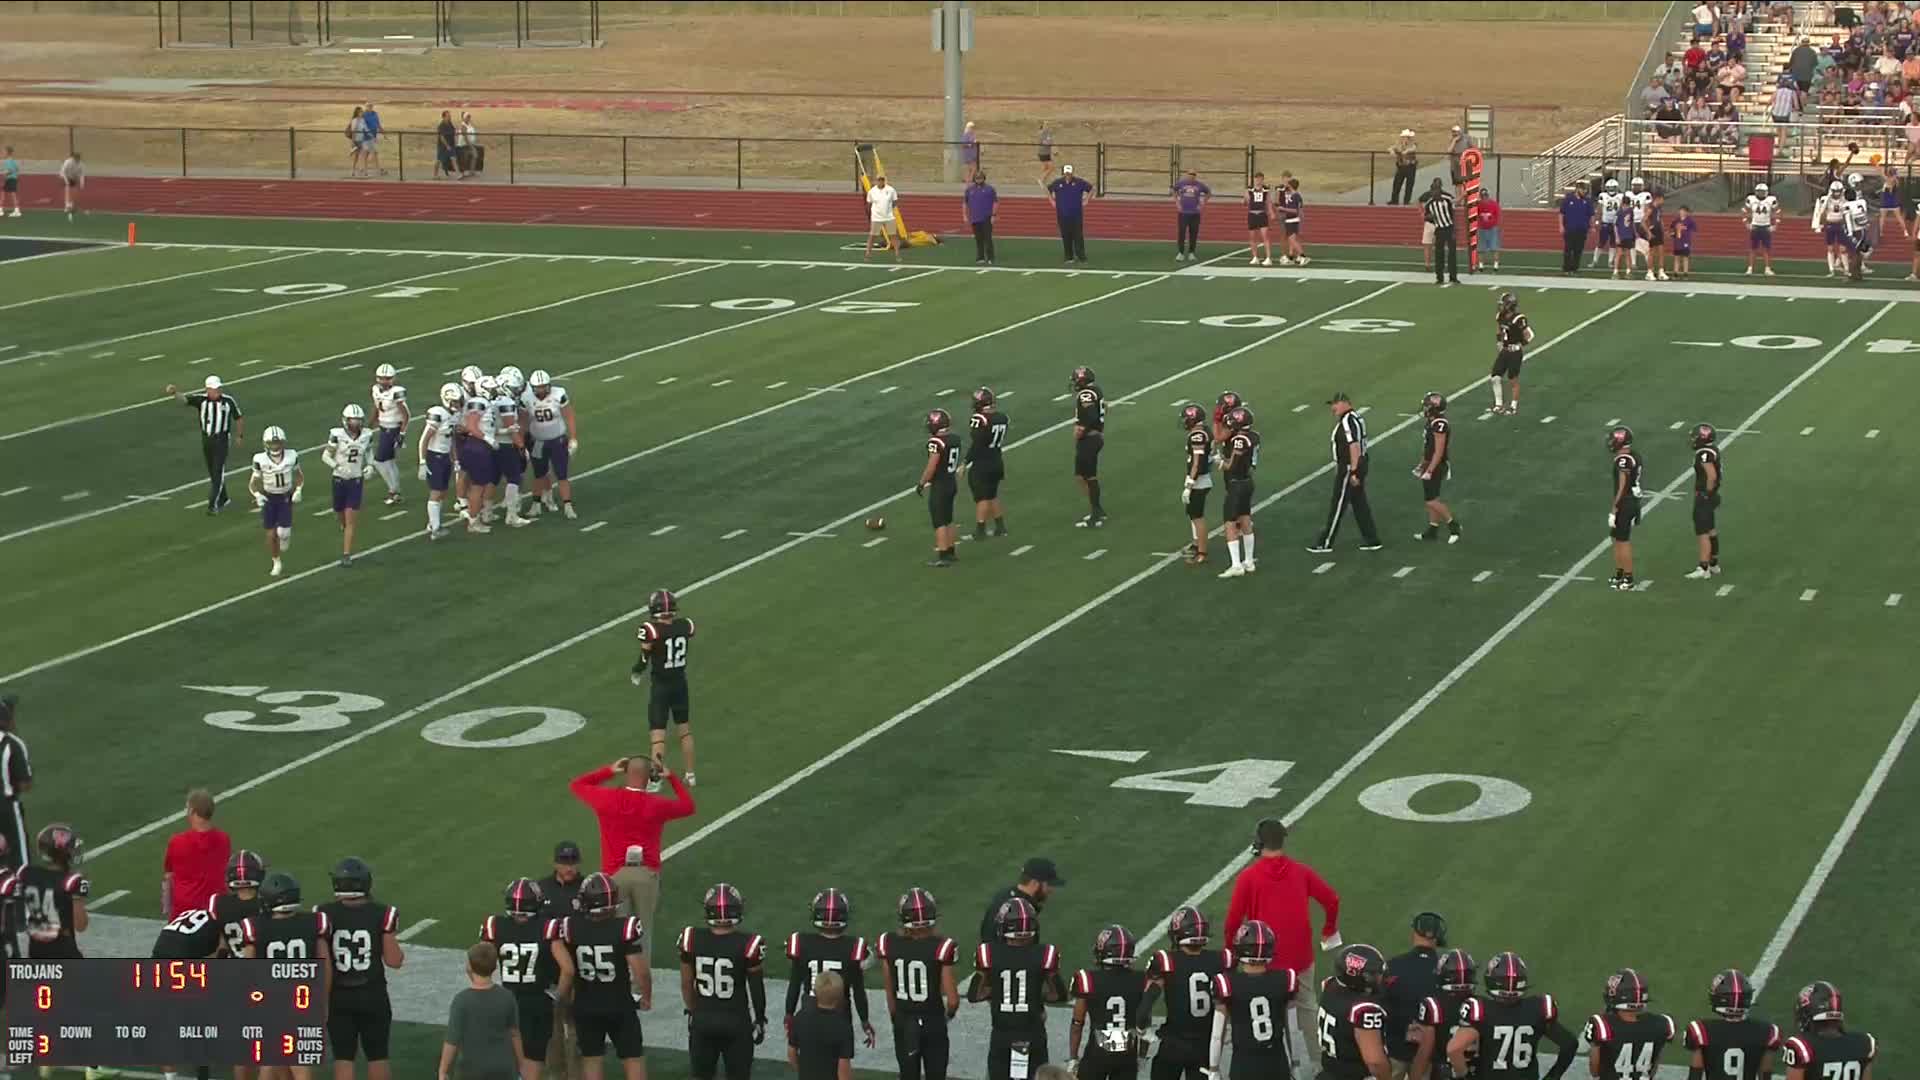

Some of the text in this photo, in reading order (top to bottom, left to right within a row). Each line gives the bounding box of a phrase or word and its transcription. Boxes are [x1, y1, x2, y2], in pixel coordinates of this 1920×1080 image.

[348, 449, 359, 463] 2
[275, 473, 285, 488] 11
[664, 636, 687, 668] 12
[163, 909, 209, 935] 29
[225, 922, 246, 958] 2
[332, 929, 372, 972] 63
[499, 943, 539, 983] 27
[576, 945, 617, 983] 65
[695, 956, 735, 999] 56
[894, 958, 929, 1002] 10
[1000, 969, 1029, 1013] 11
[1189, 972, 1212, 1018] 6
[1249, 996, 1274, 1041] 8
[1363, 1013, 1383, 1028] 55
[1493, 1025, 1534, 1070] 76
[1614, 1042, 1655, 1080] 44
[1724, 1048, 1745, 1080] 9
